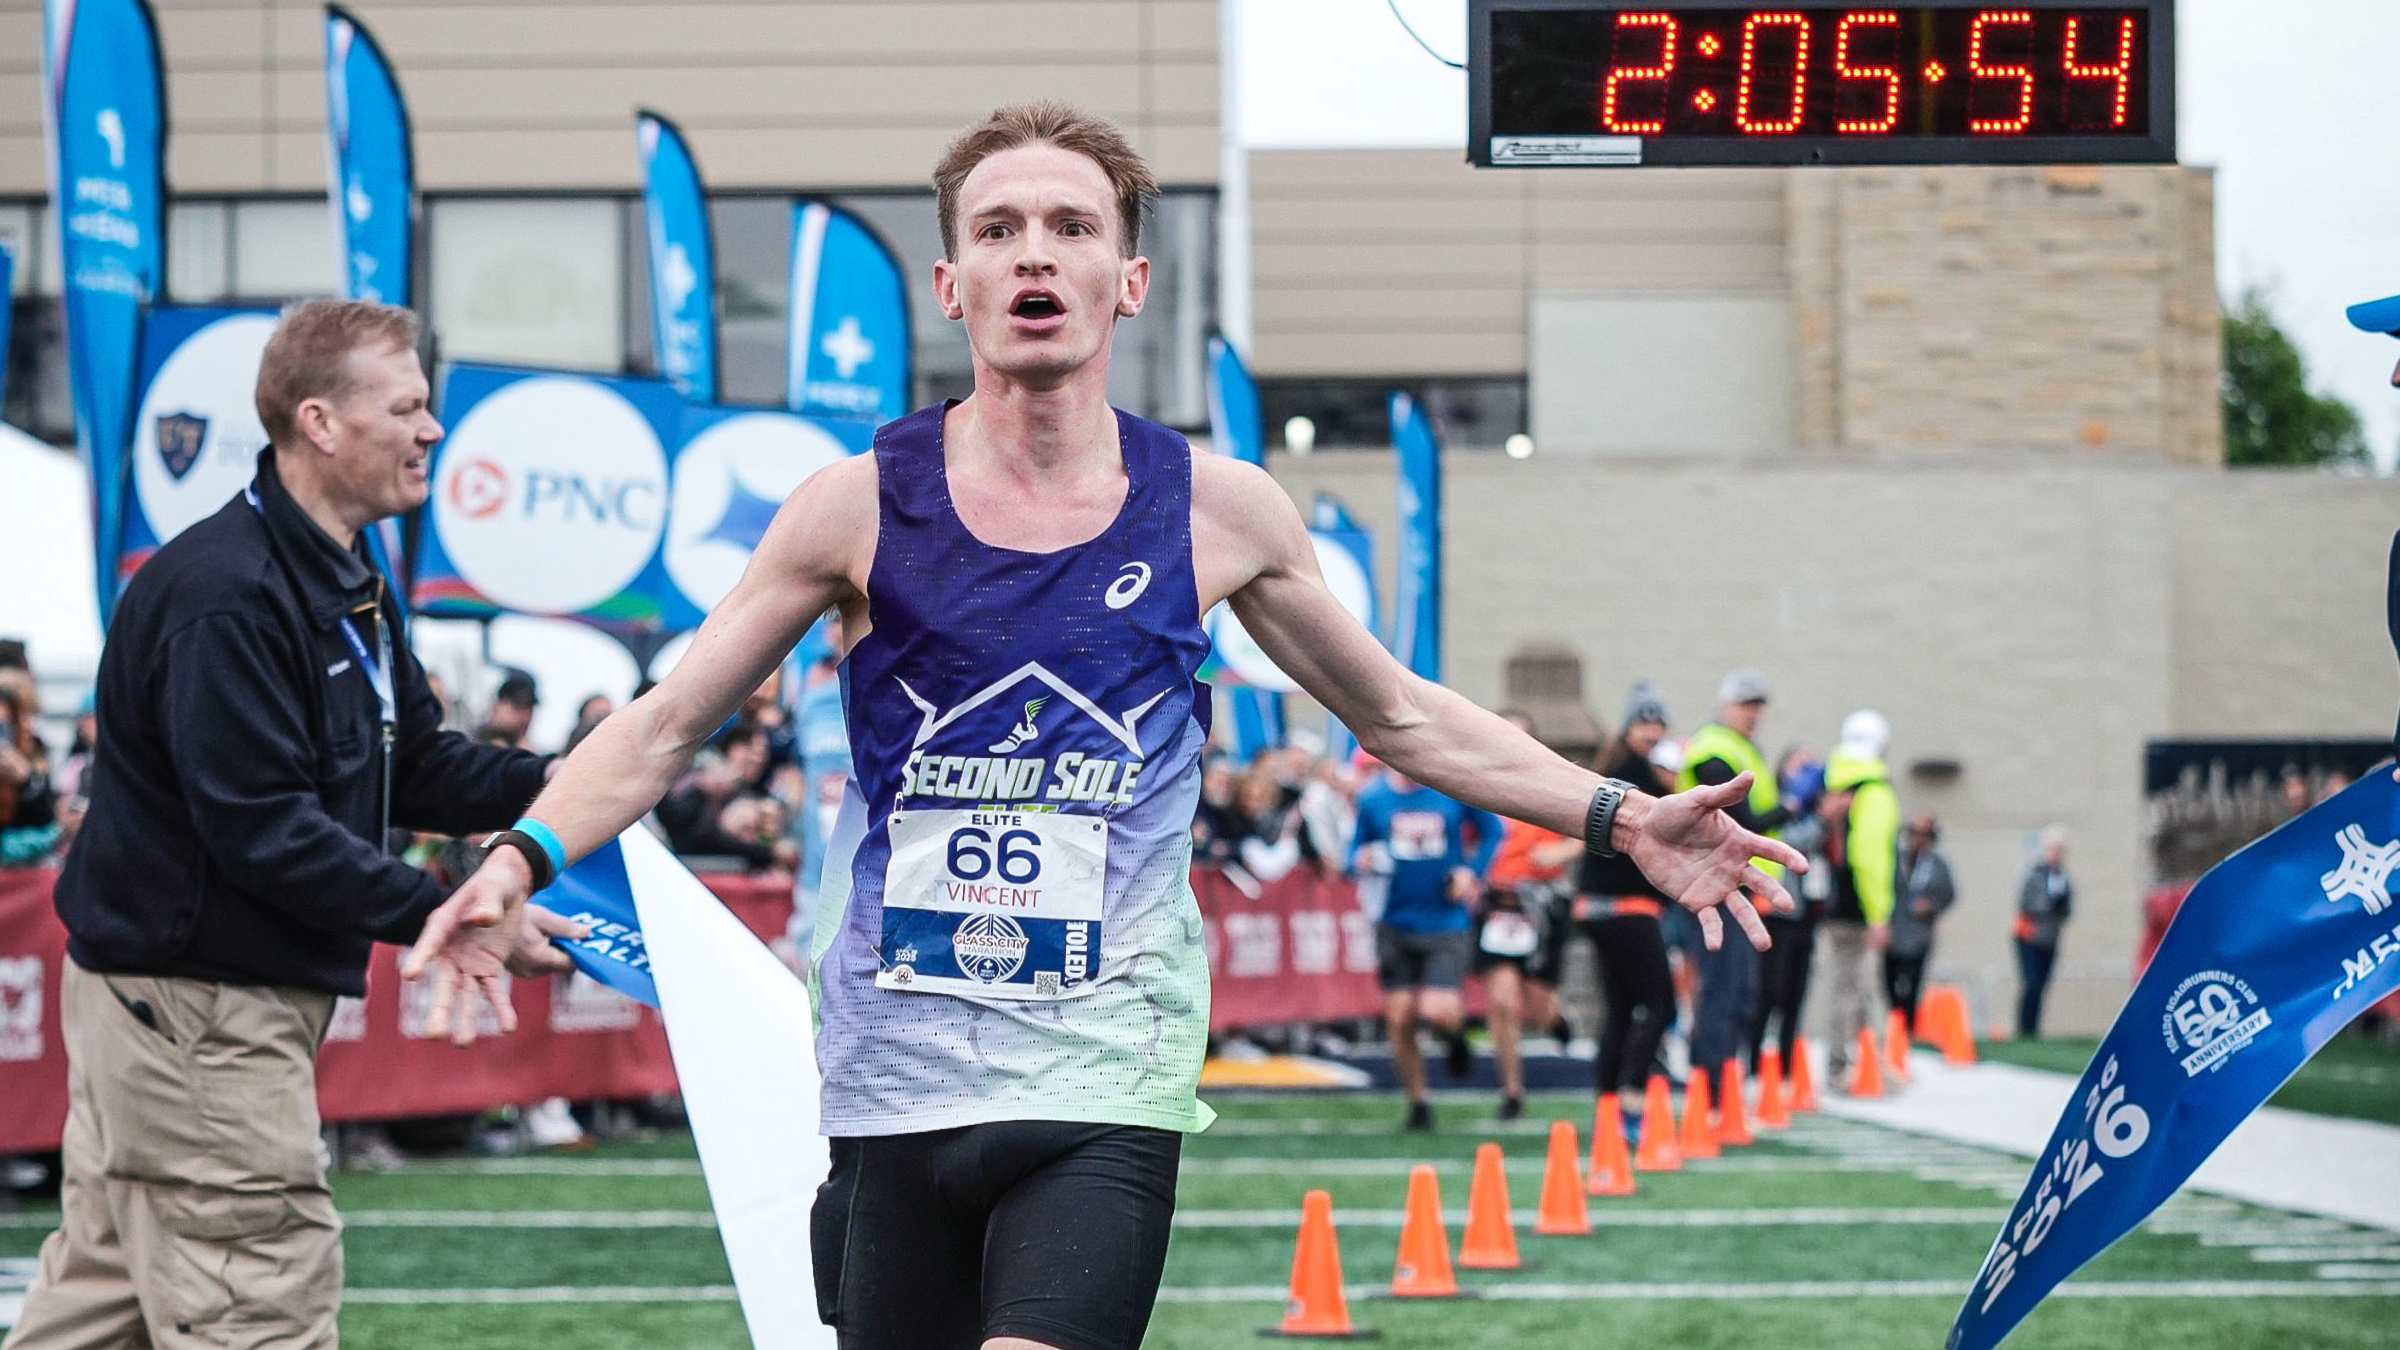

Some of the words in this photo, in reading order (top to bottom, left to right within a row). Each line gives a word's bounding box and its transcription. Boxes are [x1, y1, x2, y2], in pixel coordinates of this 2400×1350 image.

[523, 472, 655, 532] PNC
[901, 749, 1046, 801] SECOND
[1046, 752, 1143, 803] SOLE
[971, 814, 1022, 827] ELITE
[946, 827, 1042, 884] 66
[946, 882, 1042, 908] VINCENT
[954, 934, 994, 948] GLASS
[997, 937, 1028, 950] CITY
[964, 946, 1016, 957] MARATHON
[2165, 969, 2236, 1012] ROADRUNNERS
[2235, 979, 2258, 1006] CLUB
[2162, 1012, 2180, 1055] TOLEDO
[2173, 983, 2242, 1049] 50
[2187, 1013, 2264, 1071] ANNIVERSARY
[1986, 1138, 2079, 1279] APRIL
[2085, 1053, 2119, 1123] 26
[1981, 1084, 2151, 1316] 2026
